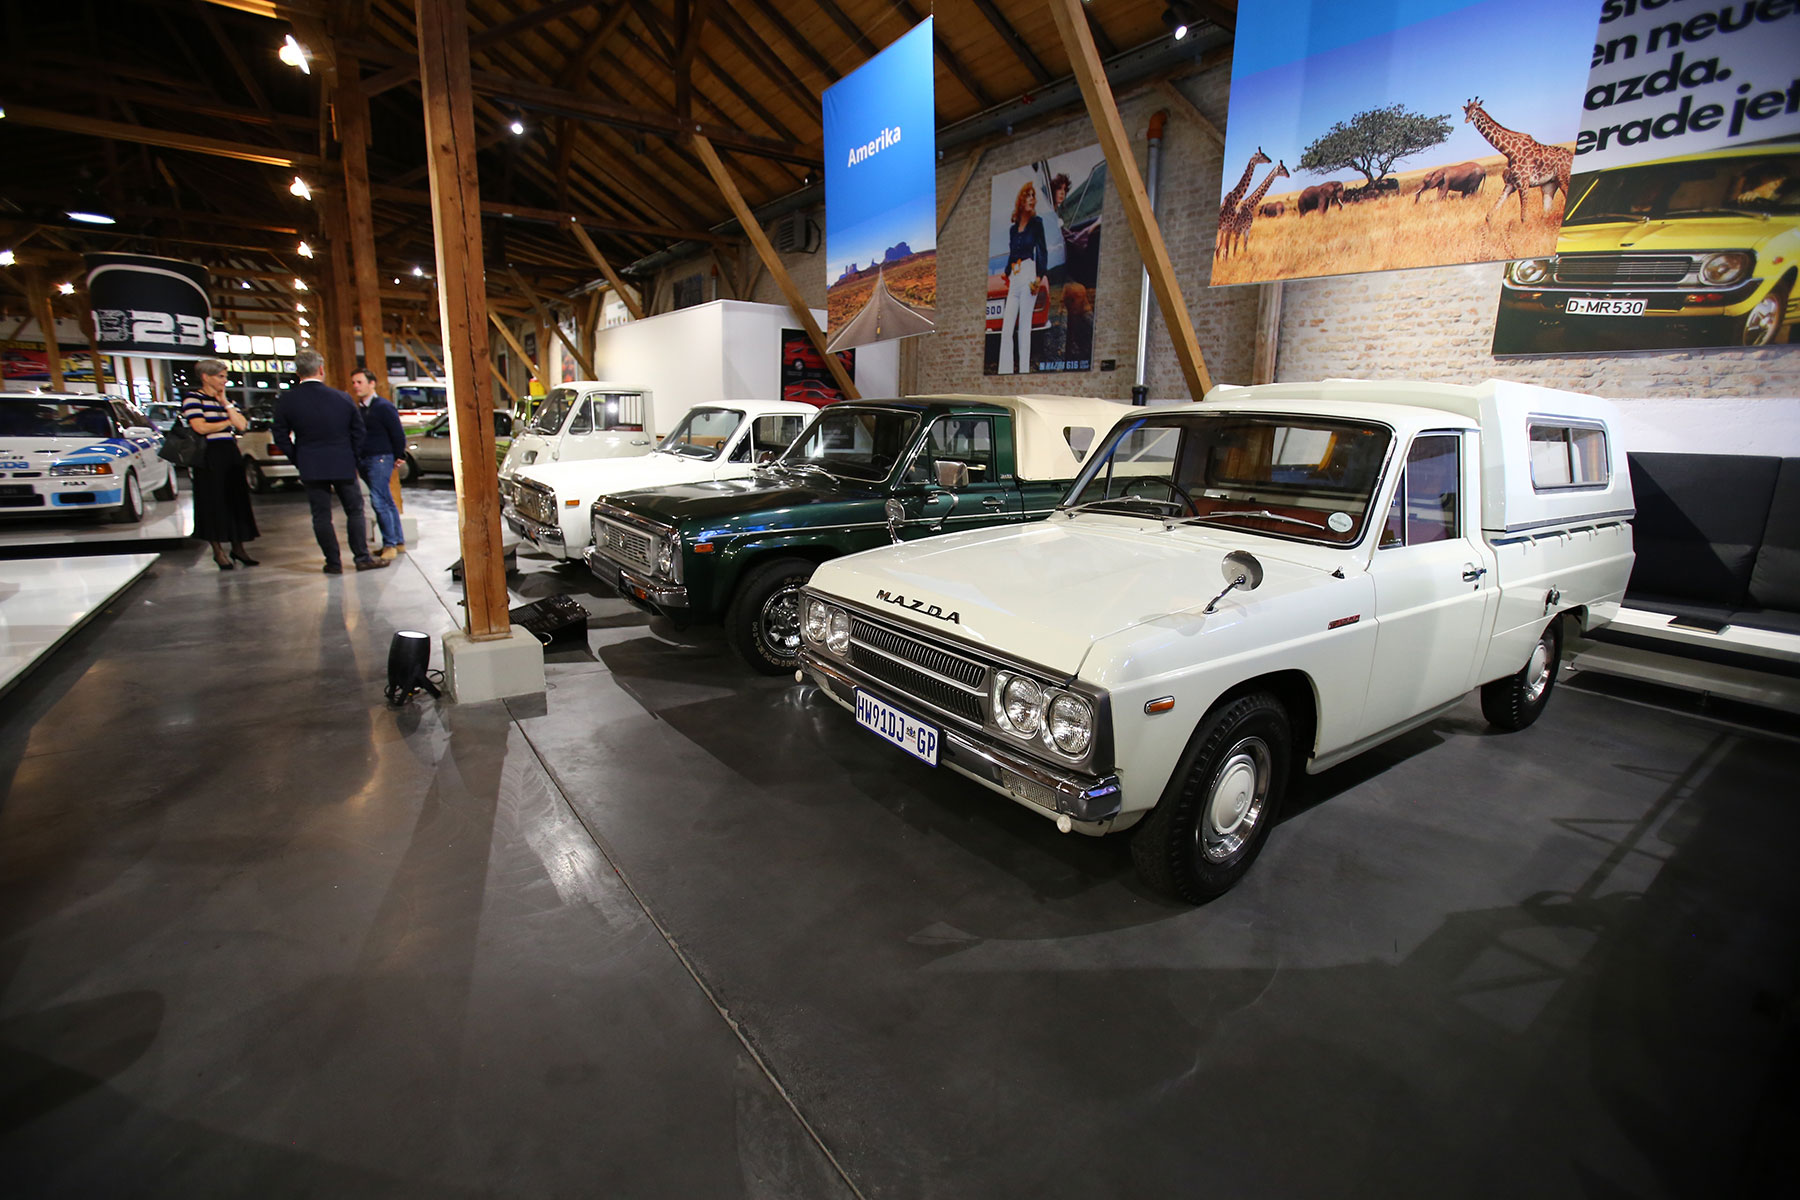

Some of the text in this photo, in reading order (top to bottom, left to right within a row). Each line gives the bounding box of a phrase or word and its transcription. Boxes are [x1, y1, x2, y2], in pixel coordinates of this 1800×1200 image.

[847, 126, 902, 168] Amerika
[875, 589, 960, 625] MAZDA
[857, 695, 936, 757] HW91DJ GP
